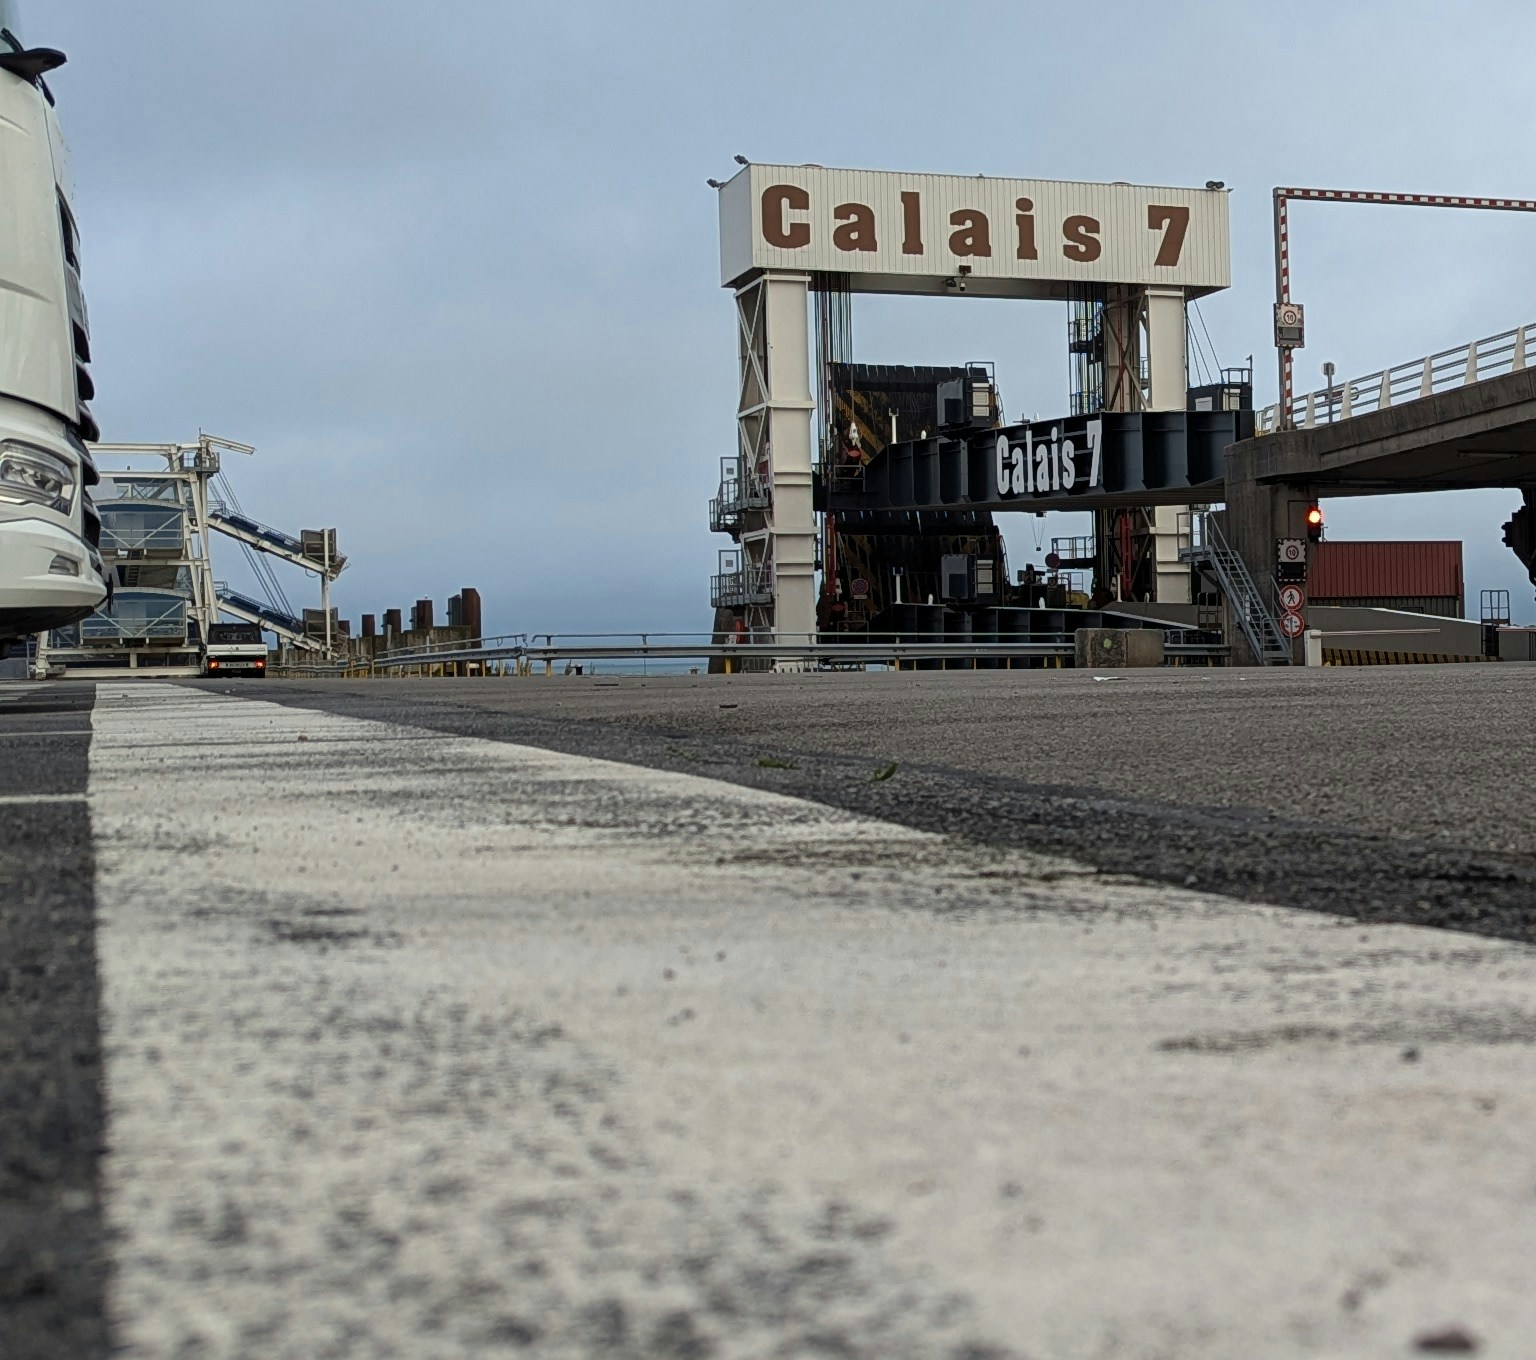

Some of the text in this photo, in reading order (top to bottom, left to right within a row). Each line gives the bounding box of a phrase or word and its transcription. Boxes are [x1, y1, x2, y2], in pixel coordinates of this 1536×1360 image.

[761, 183, 1190, 267] Calais 7
[996, 419, 1102, 495] Calais 7
